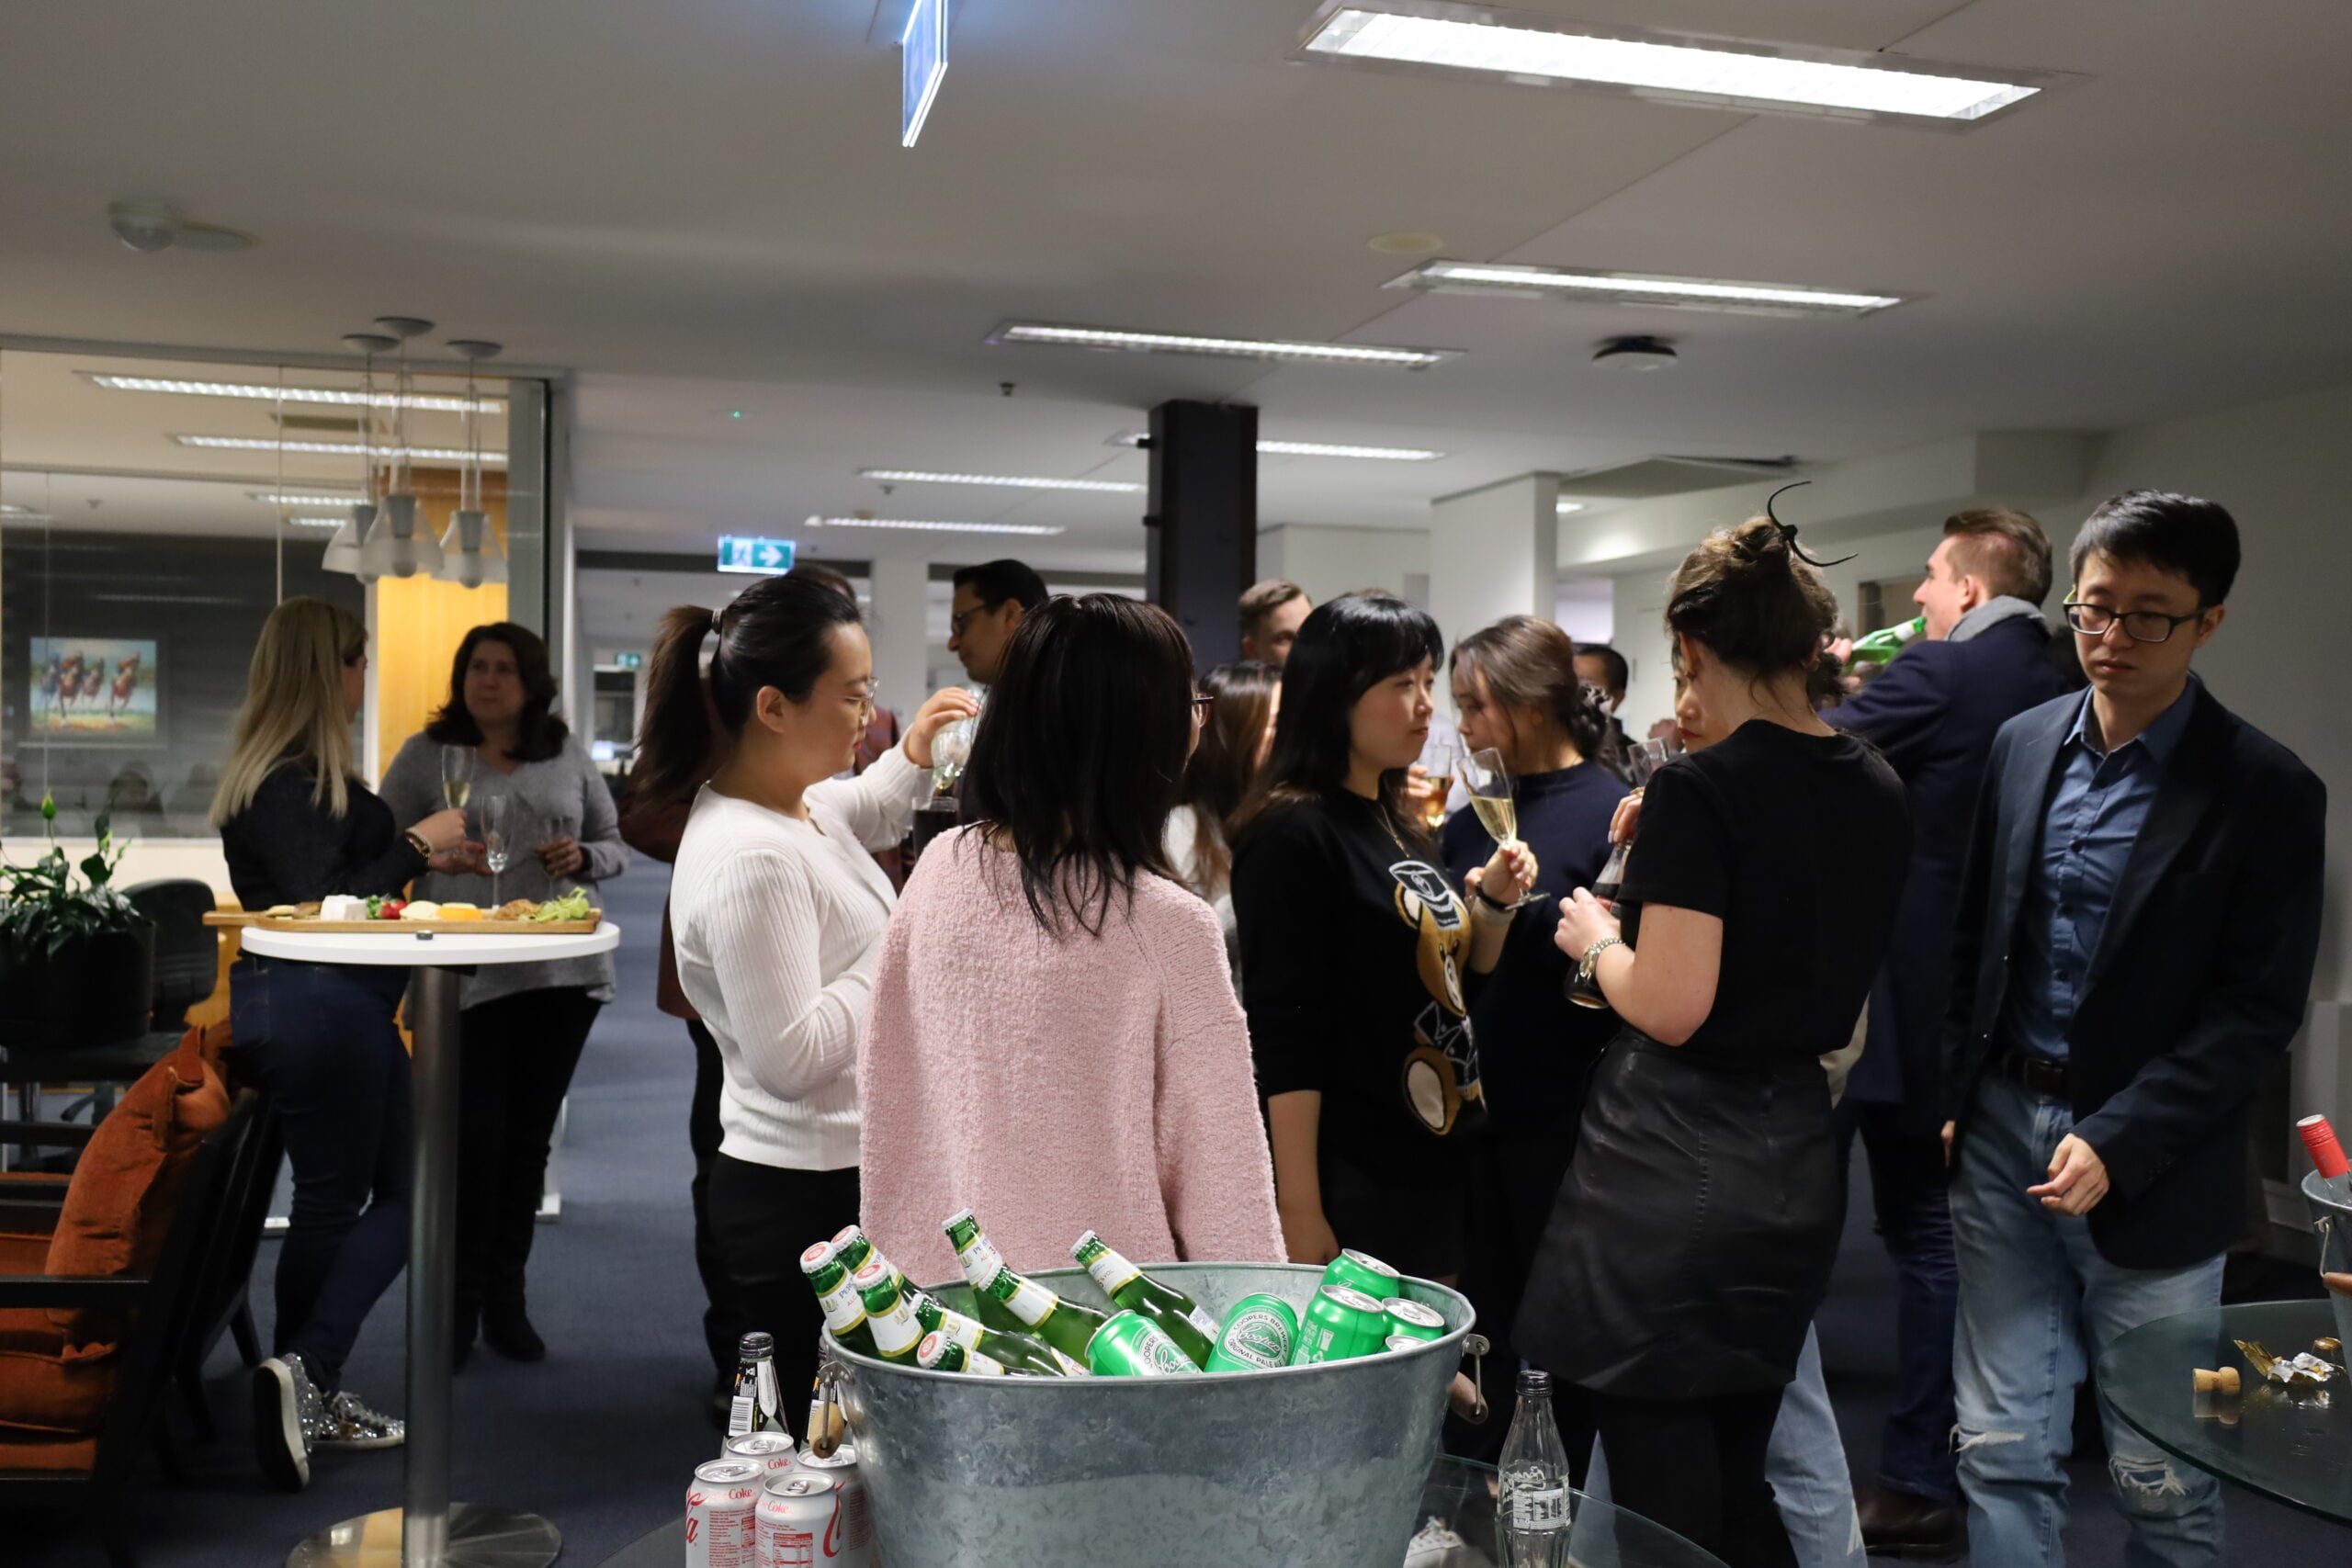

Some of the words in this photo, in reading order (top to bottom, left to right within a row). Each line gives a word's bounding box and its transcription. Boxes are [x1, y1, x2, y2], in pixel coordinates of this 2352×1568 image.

[1233, 1314, 1269, 1331] COOPERS
[1227, 1338, 1254, 1360] ORIGINAL
[1256, 1357, 1273, 1369] PALE
[767, 1458, 789, 1471] Coke
[729, 1487, 752, 1500] Coke
[767, 1499, 790, 1515] Coke
